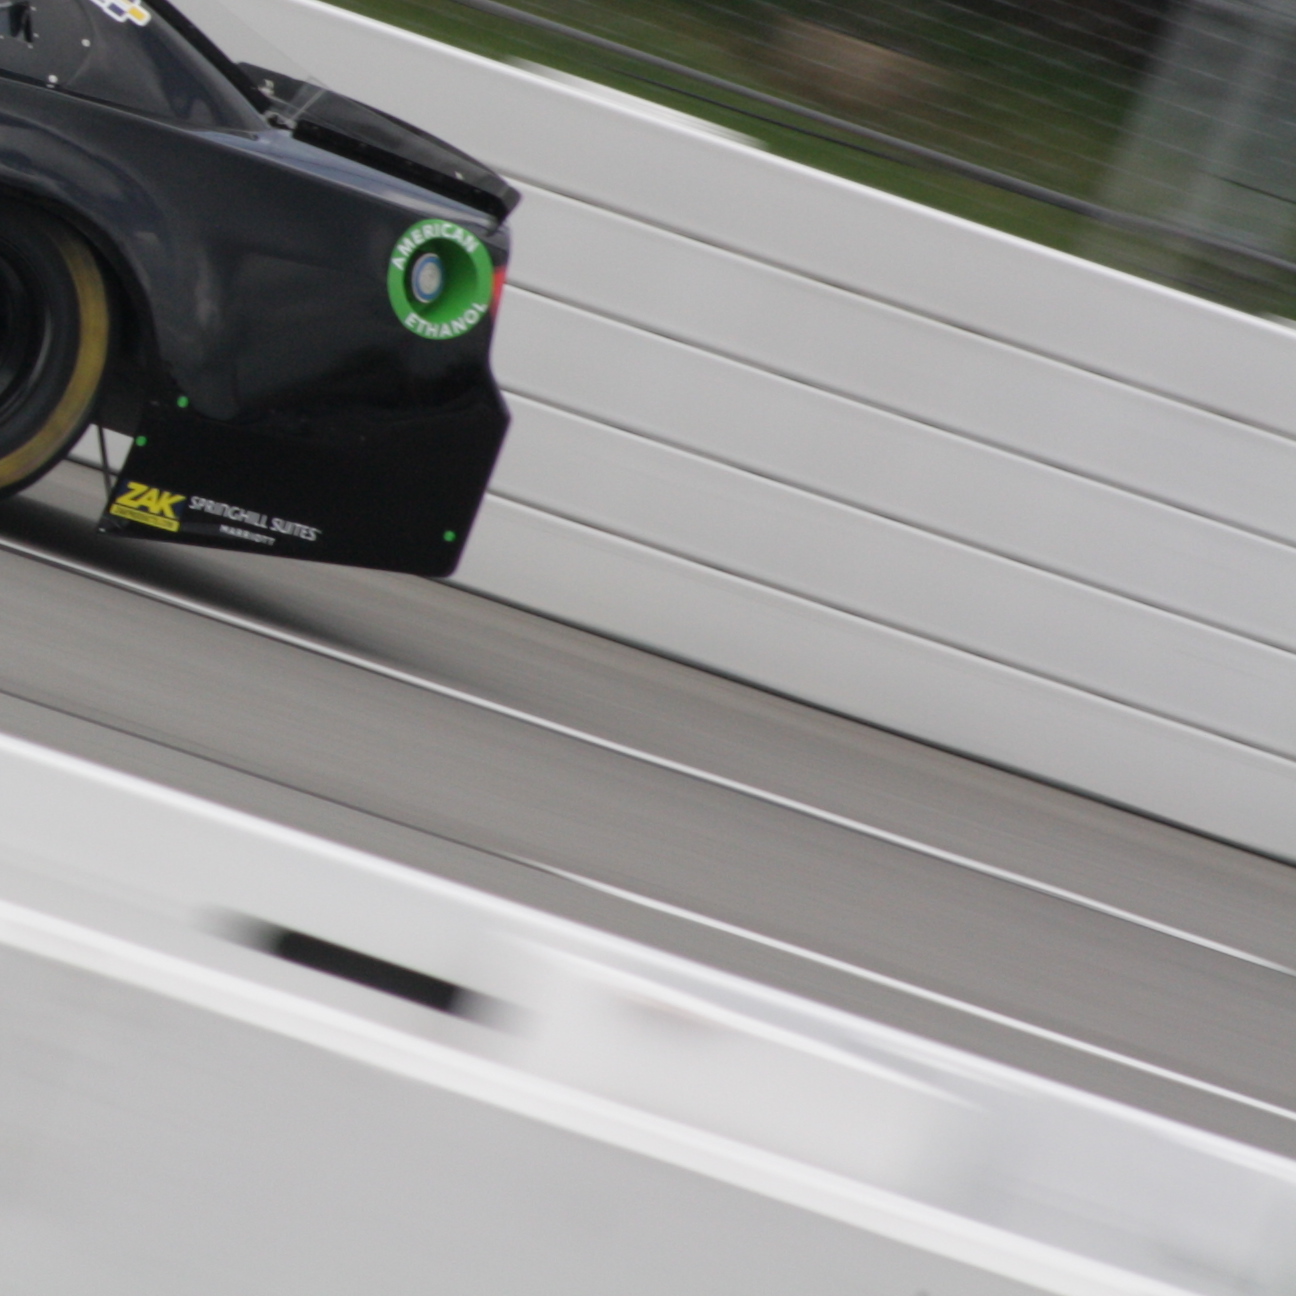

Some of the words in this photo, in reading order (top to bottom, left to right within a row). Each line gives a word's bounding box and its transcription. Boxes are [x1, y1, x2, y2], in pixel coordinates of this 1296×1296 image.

[391, 223, 479, 271] AMERICAN
[405, 302, 487, 337] ETHANOL
[116, 481, 186, 519] ZAK
[189, 495, 268, 530] SPRINGHILL
[270, 517, 322, 542] SUITES
